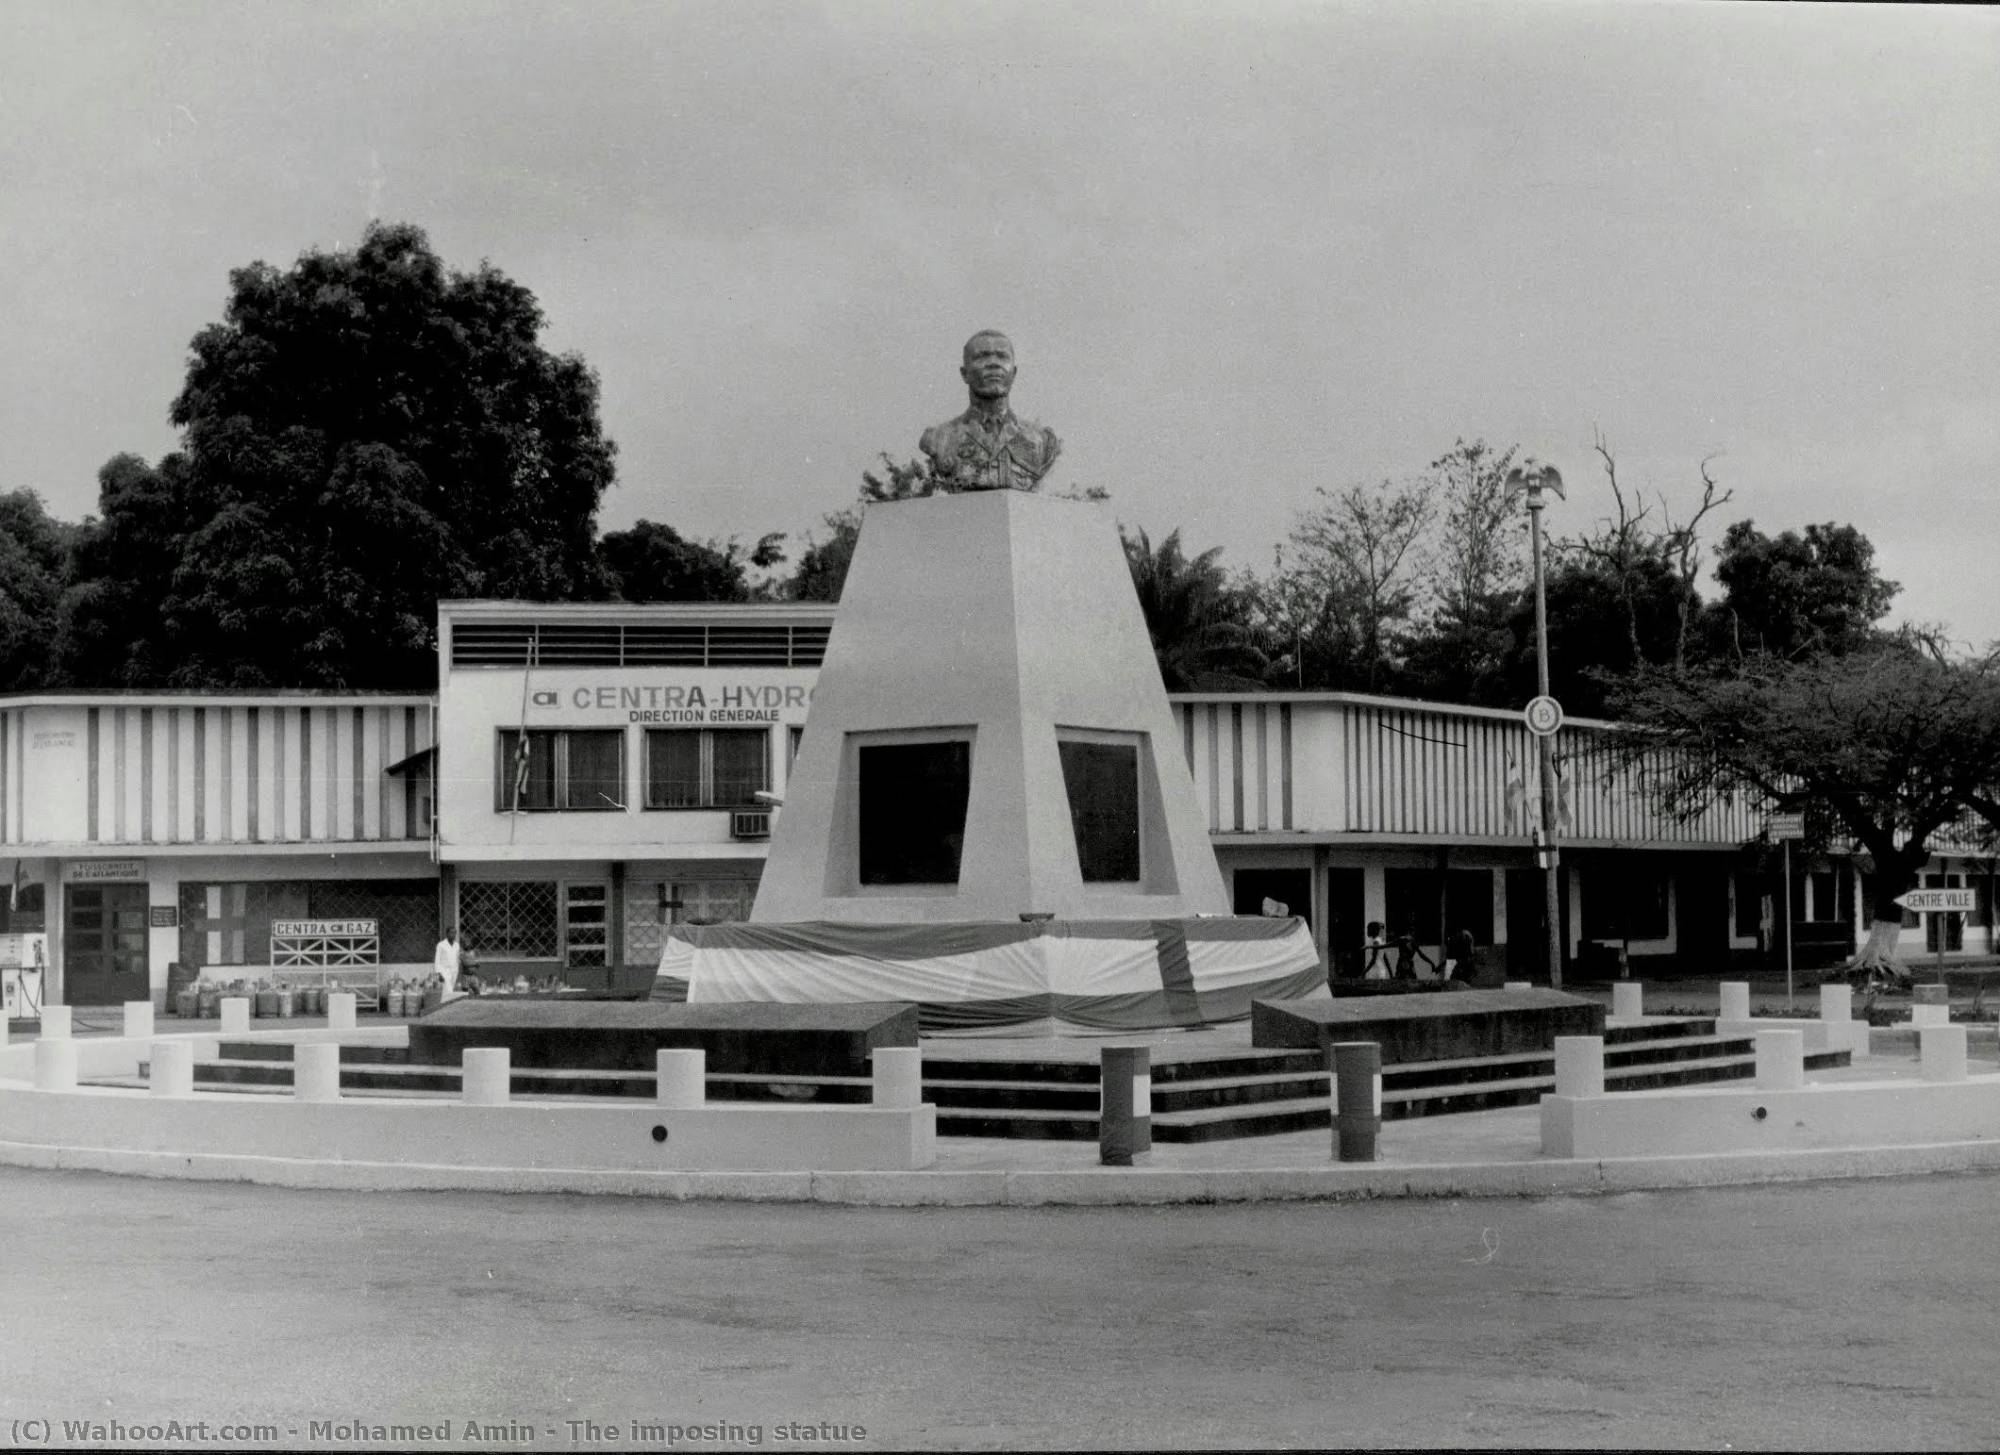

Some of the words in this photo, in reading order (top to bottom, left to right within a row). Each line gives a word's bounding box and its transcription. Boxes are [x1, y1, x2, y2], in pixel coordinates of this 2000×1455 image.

[629, 710, 704, 723] DIRECTION
[709, 709, 780, 722] GENERALE
[1539, 709, 1551, 722] B
[1907, 893, 1943, 907] CENTRE
[1945, 892, 1970, 906] VILLE
[277, 923, 327, 935] CENTRA
[346, 922, 372, 934] GAZ
